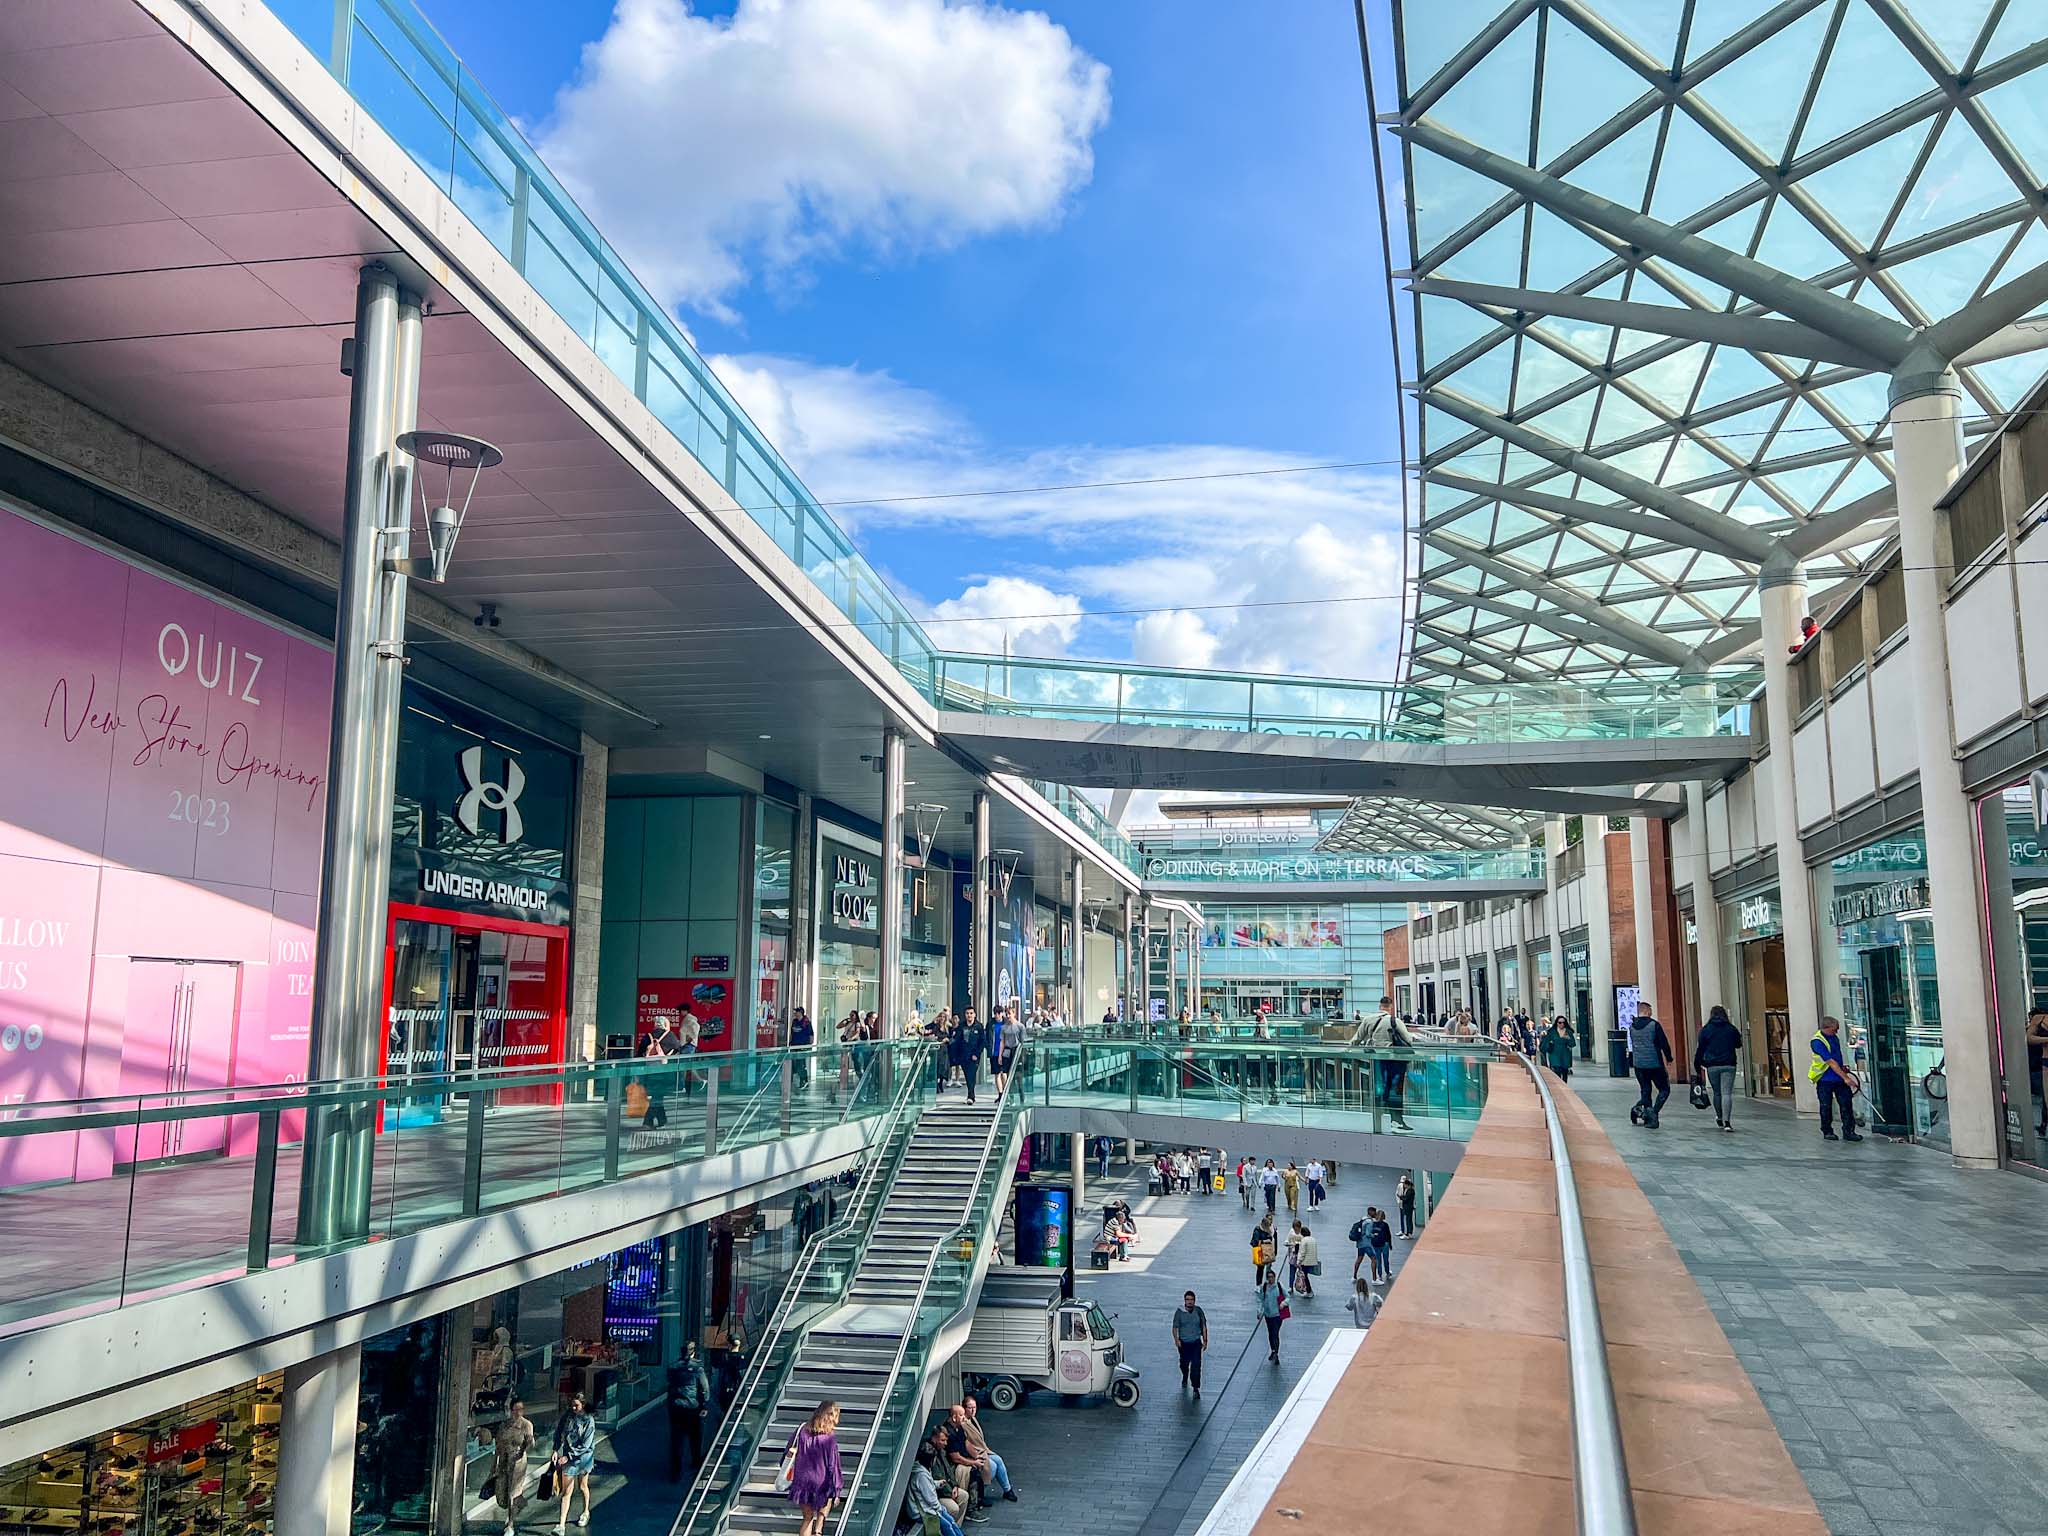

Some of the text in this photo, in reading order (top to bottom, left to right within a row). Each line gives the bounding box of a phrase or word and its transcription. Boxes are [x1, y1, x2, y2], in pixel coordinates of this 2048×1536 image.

[158, 622, 264, 705] QUIZ
[44, 672, 327, 812] New Store Opening
[167, 789, 232, 836] 2023
[1217, 830, 1299, 847] John Lewis
[836, 854, 871, 888] NEW
[1165, 858, 1426, 877] DINING & MORE ON THE TERRACE
[423, 868, 548, 911] UNDER ARMOUR
[832, 889, 872, 922] LOOK
[1741, 896, 1769, 930] Bershka
[276, 940, 311, 966] JOIN
[647, 1007, 680, 1016] TERRACE
[153, 1433, 180, 1455] SALE
